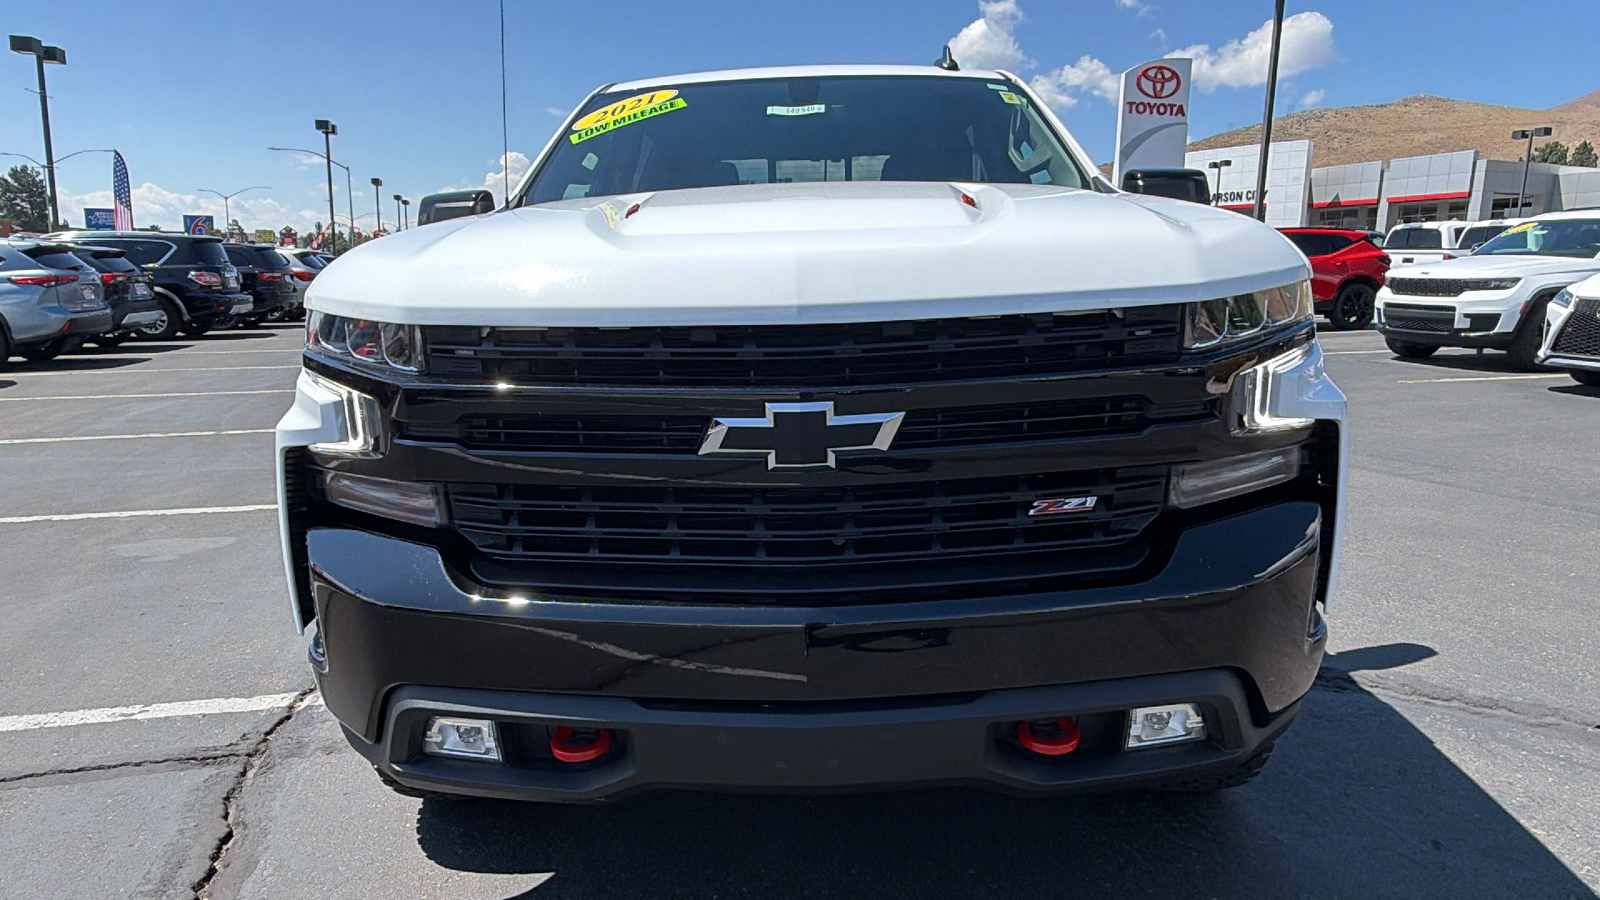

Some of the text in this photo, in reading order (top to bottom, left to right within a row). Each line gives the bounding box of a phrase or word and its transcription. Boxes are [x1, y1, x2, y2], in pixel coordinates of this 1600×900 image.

[594, 93, 657, 124] 2021
[1126, 101, 1186, 117] TOYOTA
[577, 100, 680, 140] LOW MILEAGE
[1210, 189, 1269, 203] ARSON CIY
[190, 216, 209, 236] 6
[1028, 496, 1098, 515] Z71
